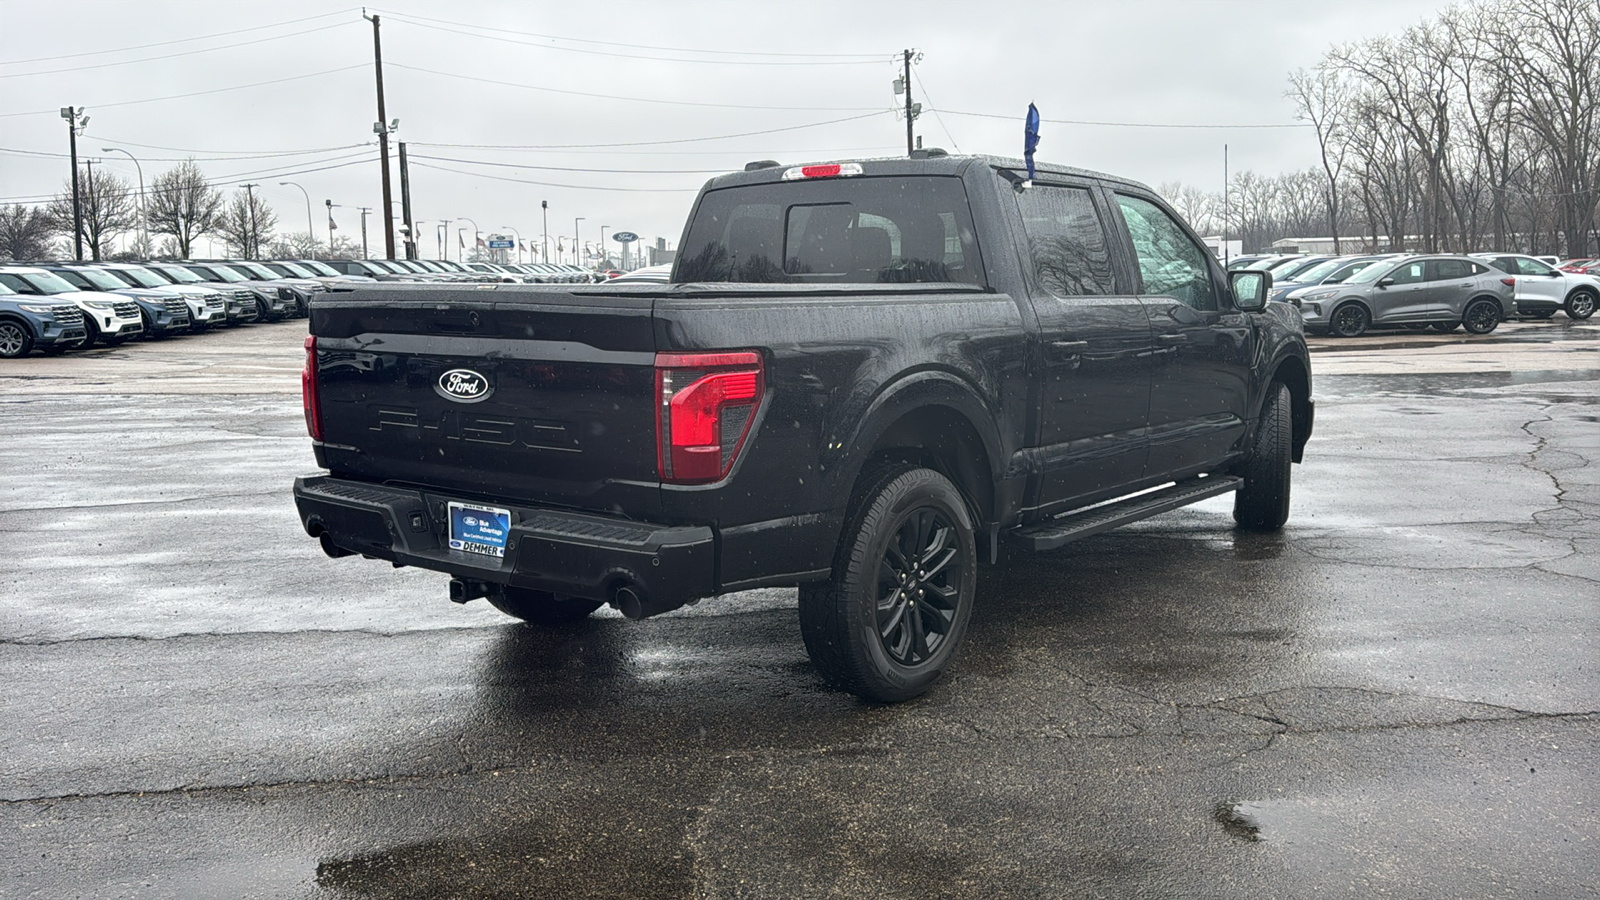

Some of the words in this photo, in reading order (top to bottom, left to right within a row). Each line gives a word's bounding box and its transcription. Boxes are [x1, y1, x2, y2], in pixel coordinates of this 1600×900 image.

[447, 372, 479, 394] Ford
[367, 404, 583, 452] F-150
[479, 527, 503, 536] Advantage
[463, 541, 498, 555] DEMMER
